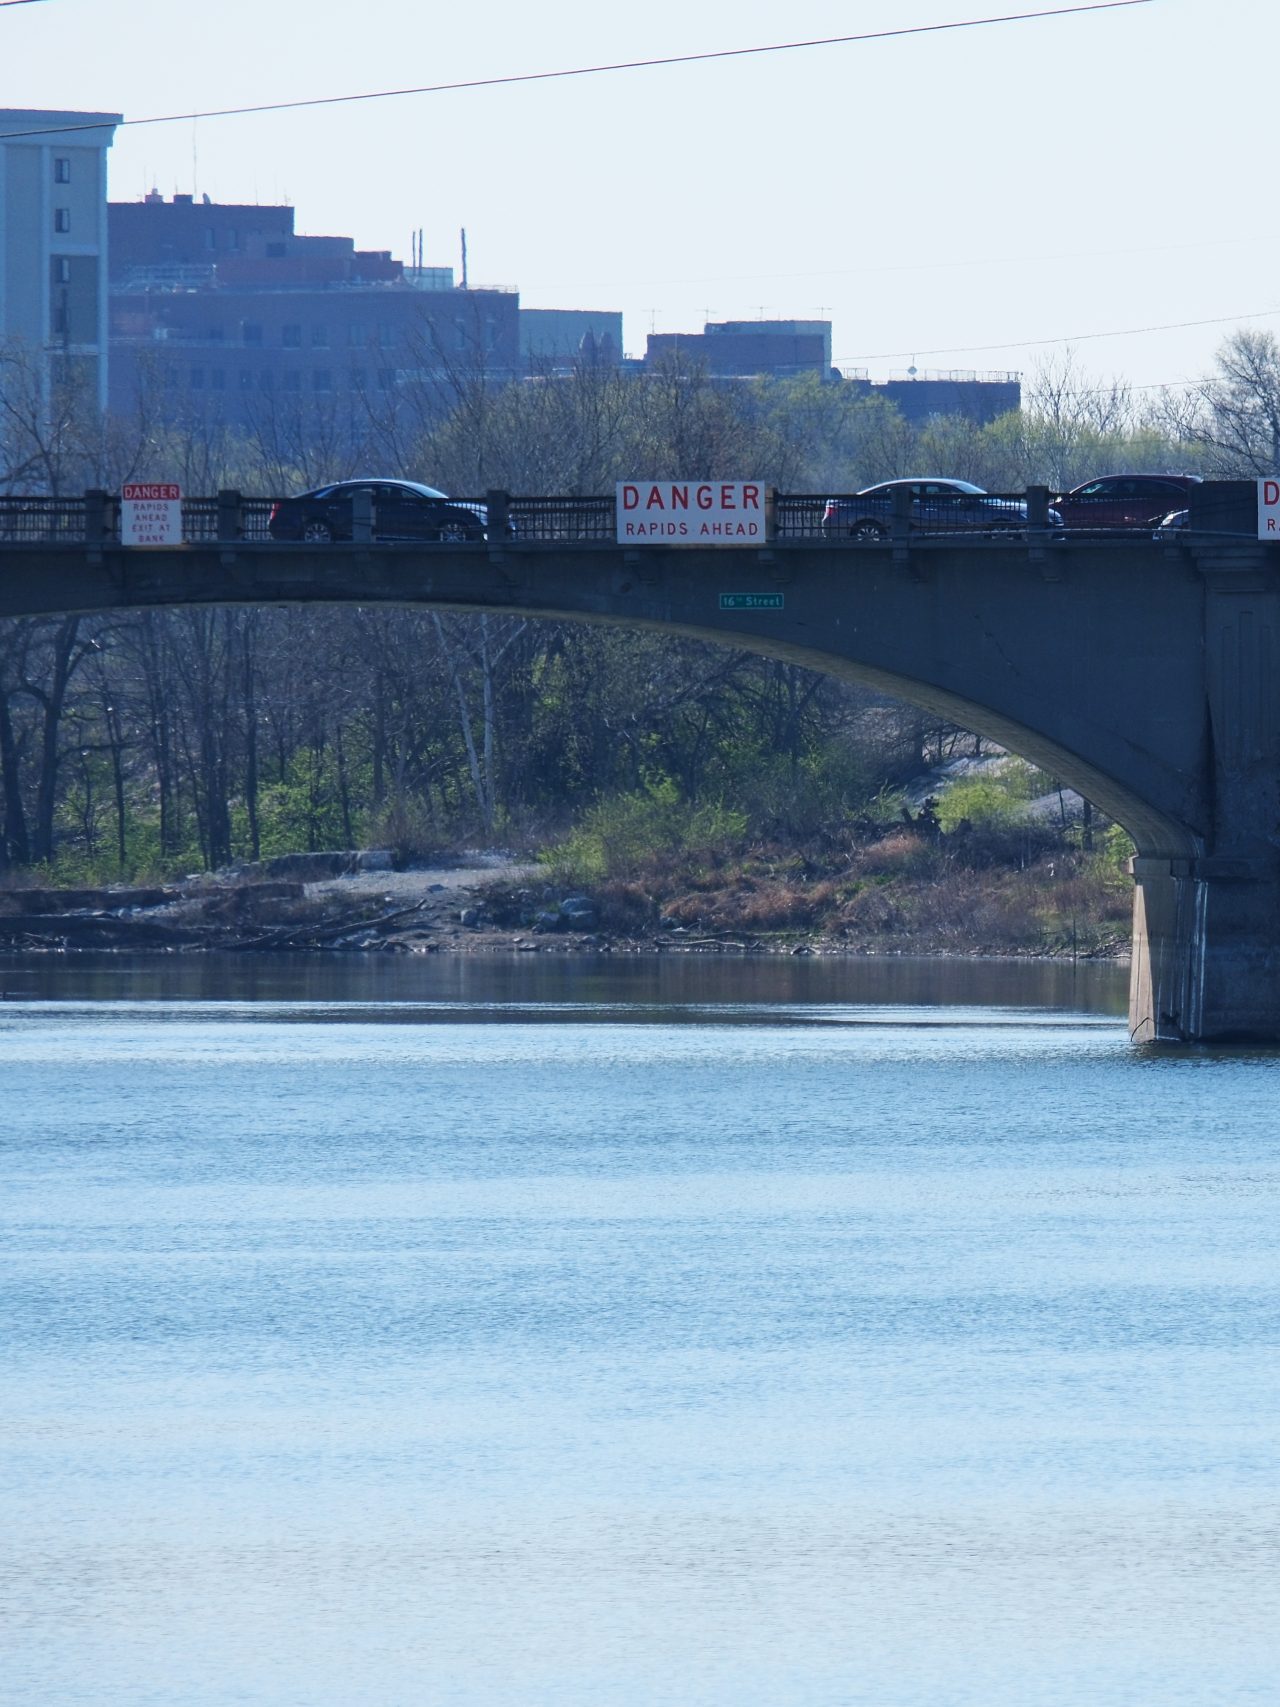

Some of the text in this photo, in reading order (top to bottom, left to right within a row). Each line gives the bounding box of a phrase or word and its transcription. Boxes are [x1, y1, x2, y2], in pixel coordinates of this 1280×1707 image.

[124, 486, 178, 499] DANGER
[623, 485, 759, 510] DANGER
[133, 503, 169, 511] RAPIDS
[135, 513, 168, 521] AHEAD
[160, 524, 170, 532] AT
[626, 522, 758, 535] RAPIDS AHEAD
[138, 535, 165, 543] BANK
[746, 596, 780, 606] Street
